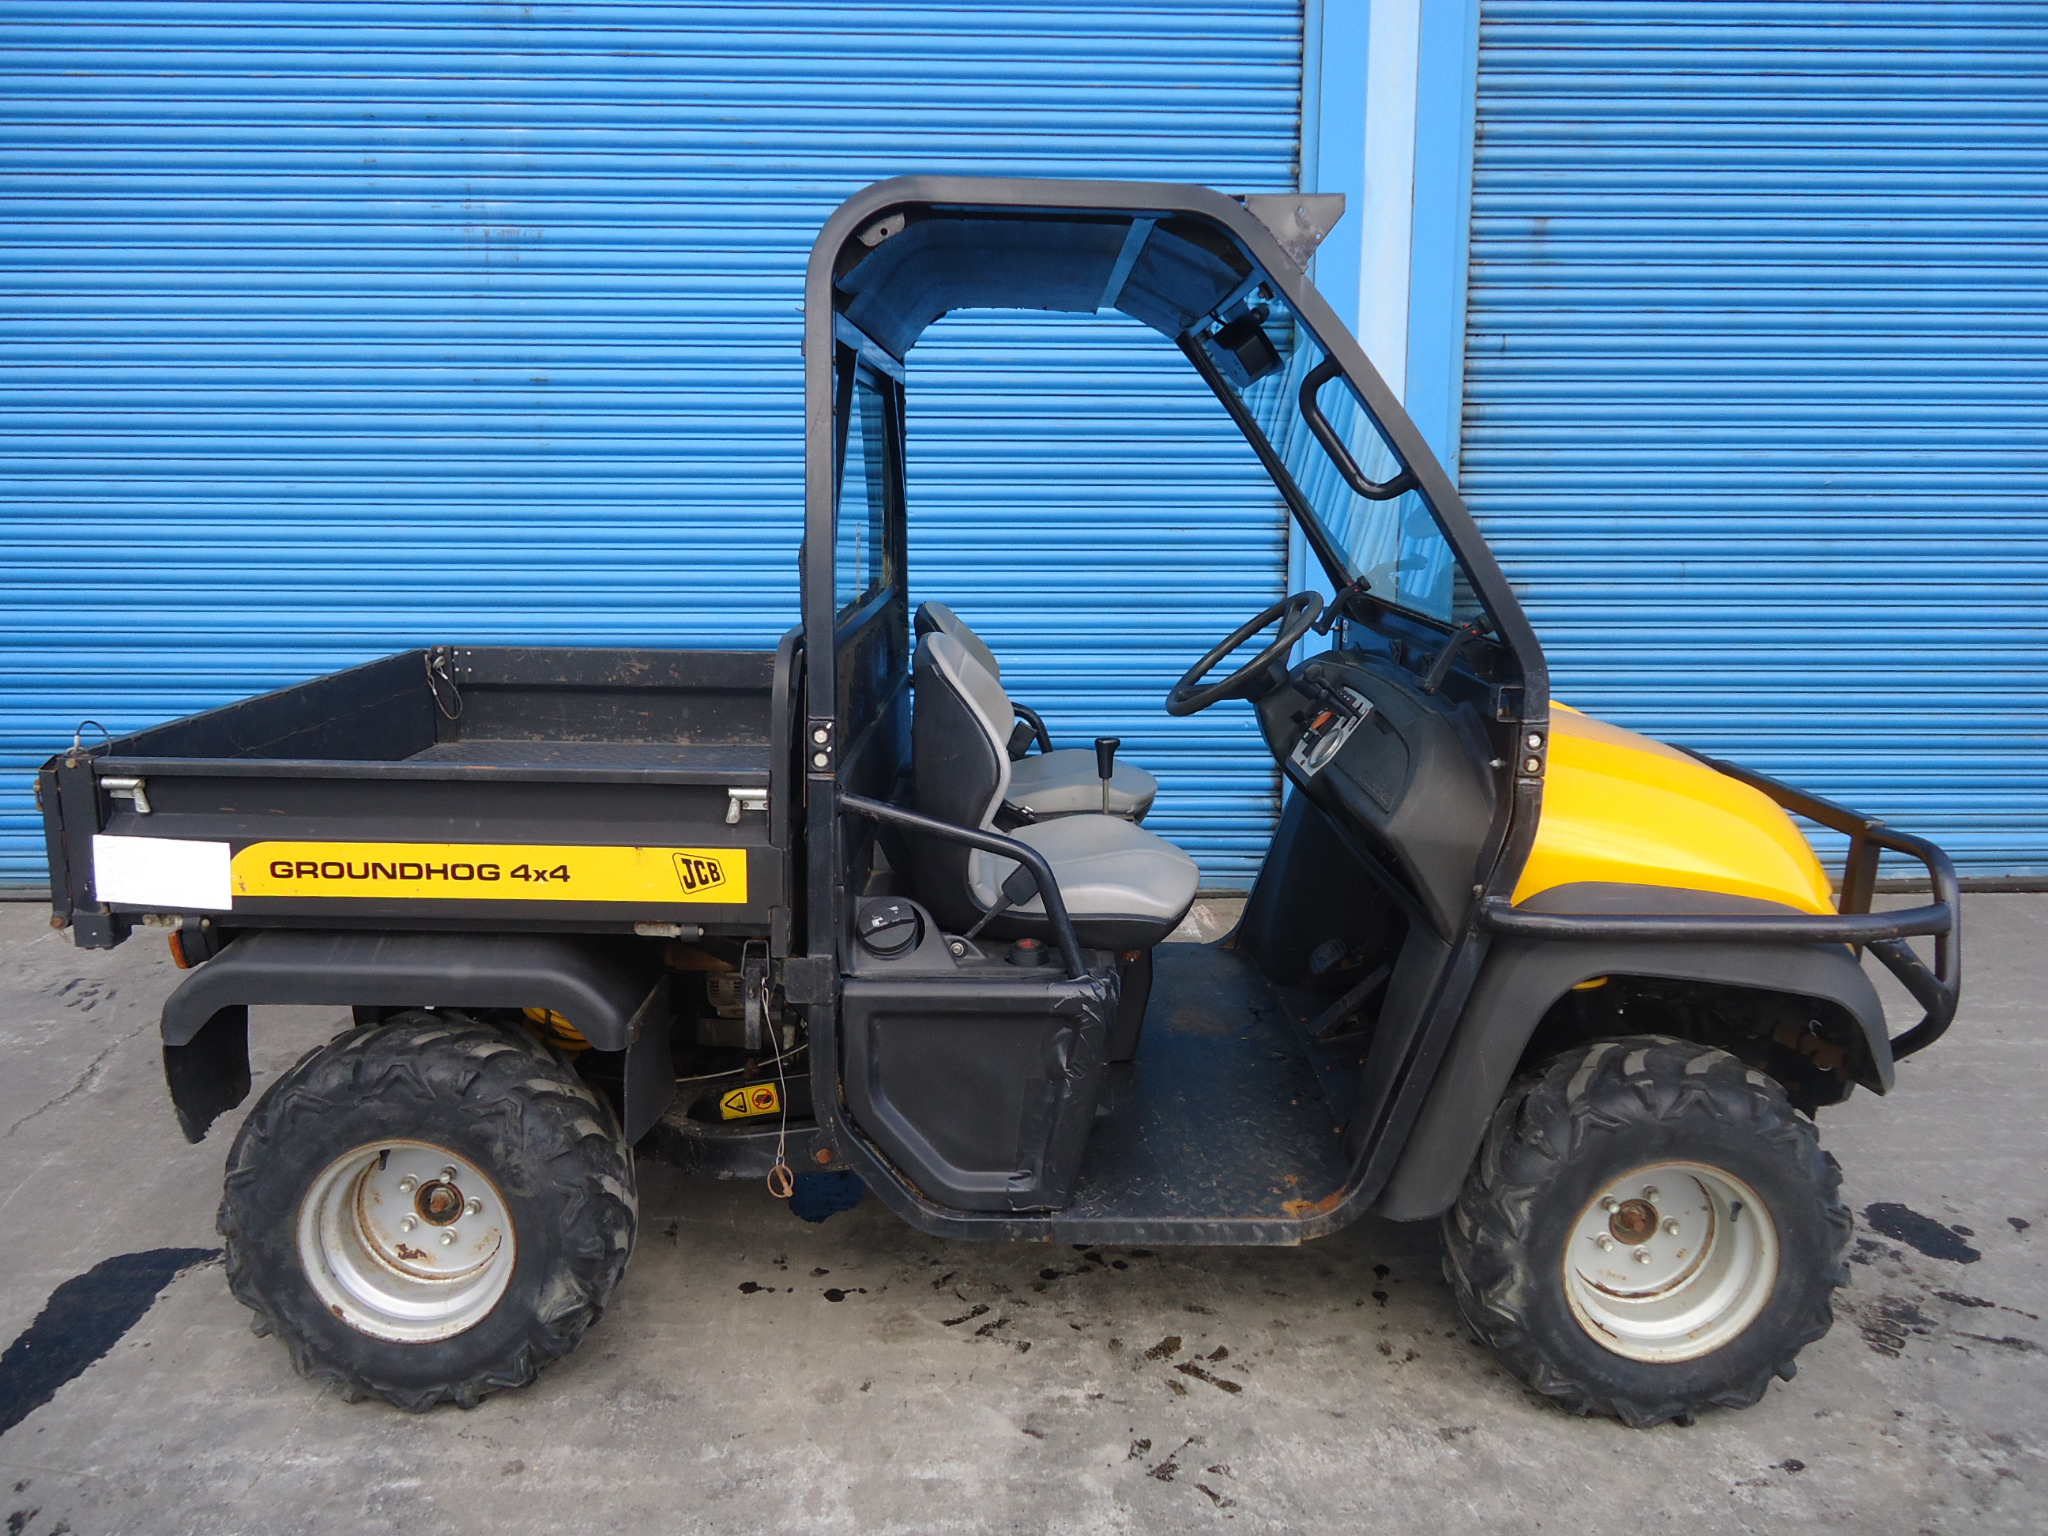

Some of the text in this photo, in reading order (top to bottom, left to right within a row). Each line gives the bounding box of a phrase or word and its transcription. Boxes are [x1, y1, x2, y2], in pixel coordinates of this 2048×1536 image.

[270, 861, 570, 882] GROUNDHOG 4x4
[681, 858, 721, 889] JCB
